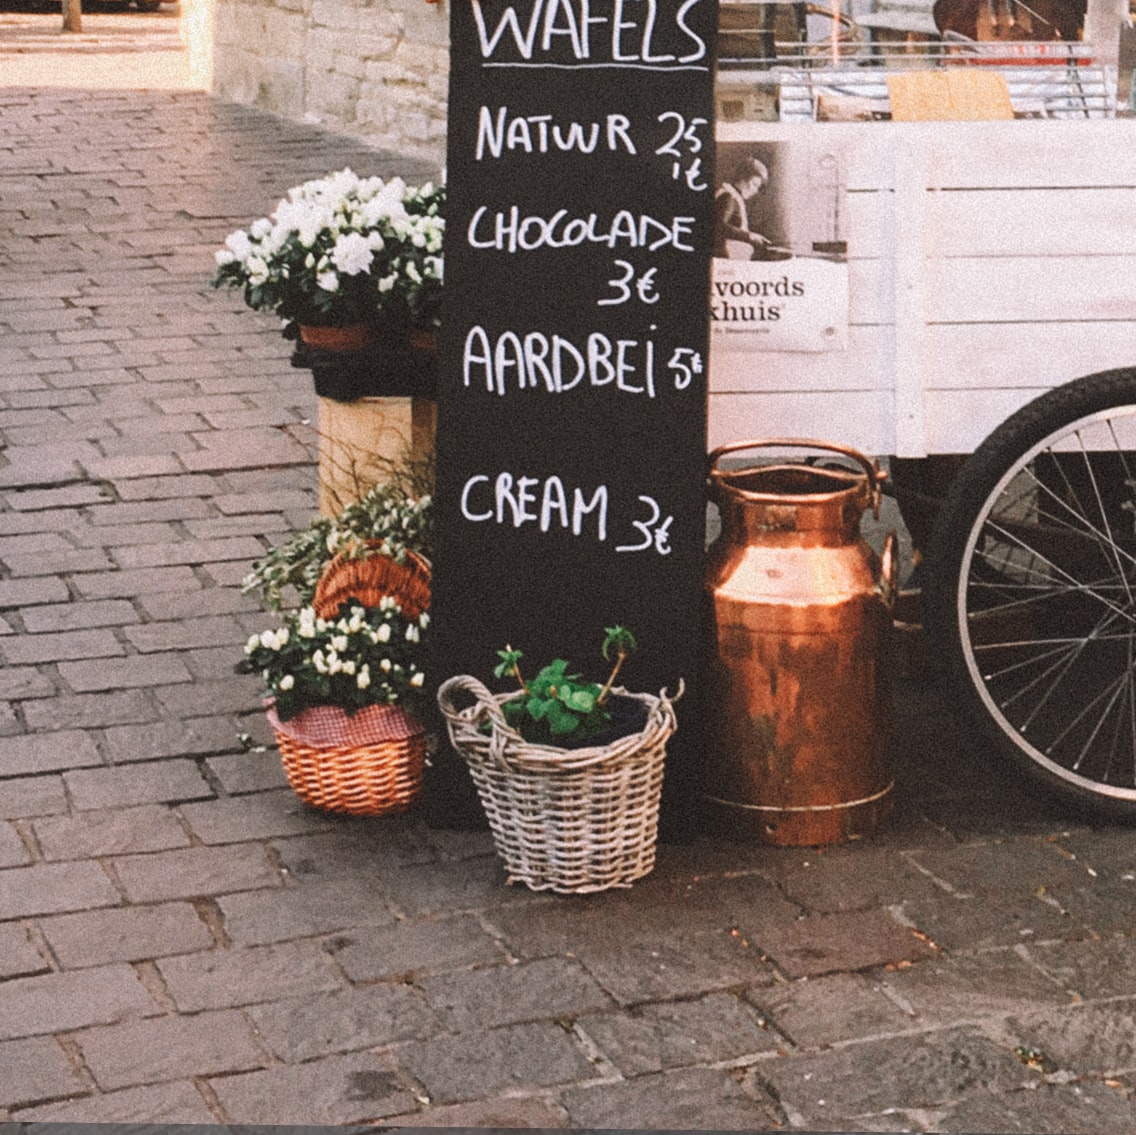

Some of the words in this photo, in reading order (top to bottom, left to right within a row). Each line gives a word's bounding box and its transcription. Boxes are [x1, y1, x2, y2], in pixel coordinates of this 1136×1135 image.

[475, 105, 637, 161] NATUUR
[467, 205, 697, 254] CHOCOLADE
[597, 259, 660, 306] 3€
[461, 471, 607, 542] CREAM
[615, 494, 674, 555] 3€
